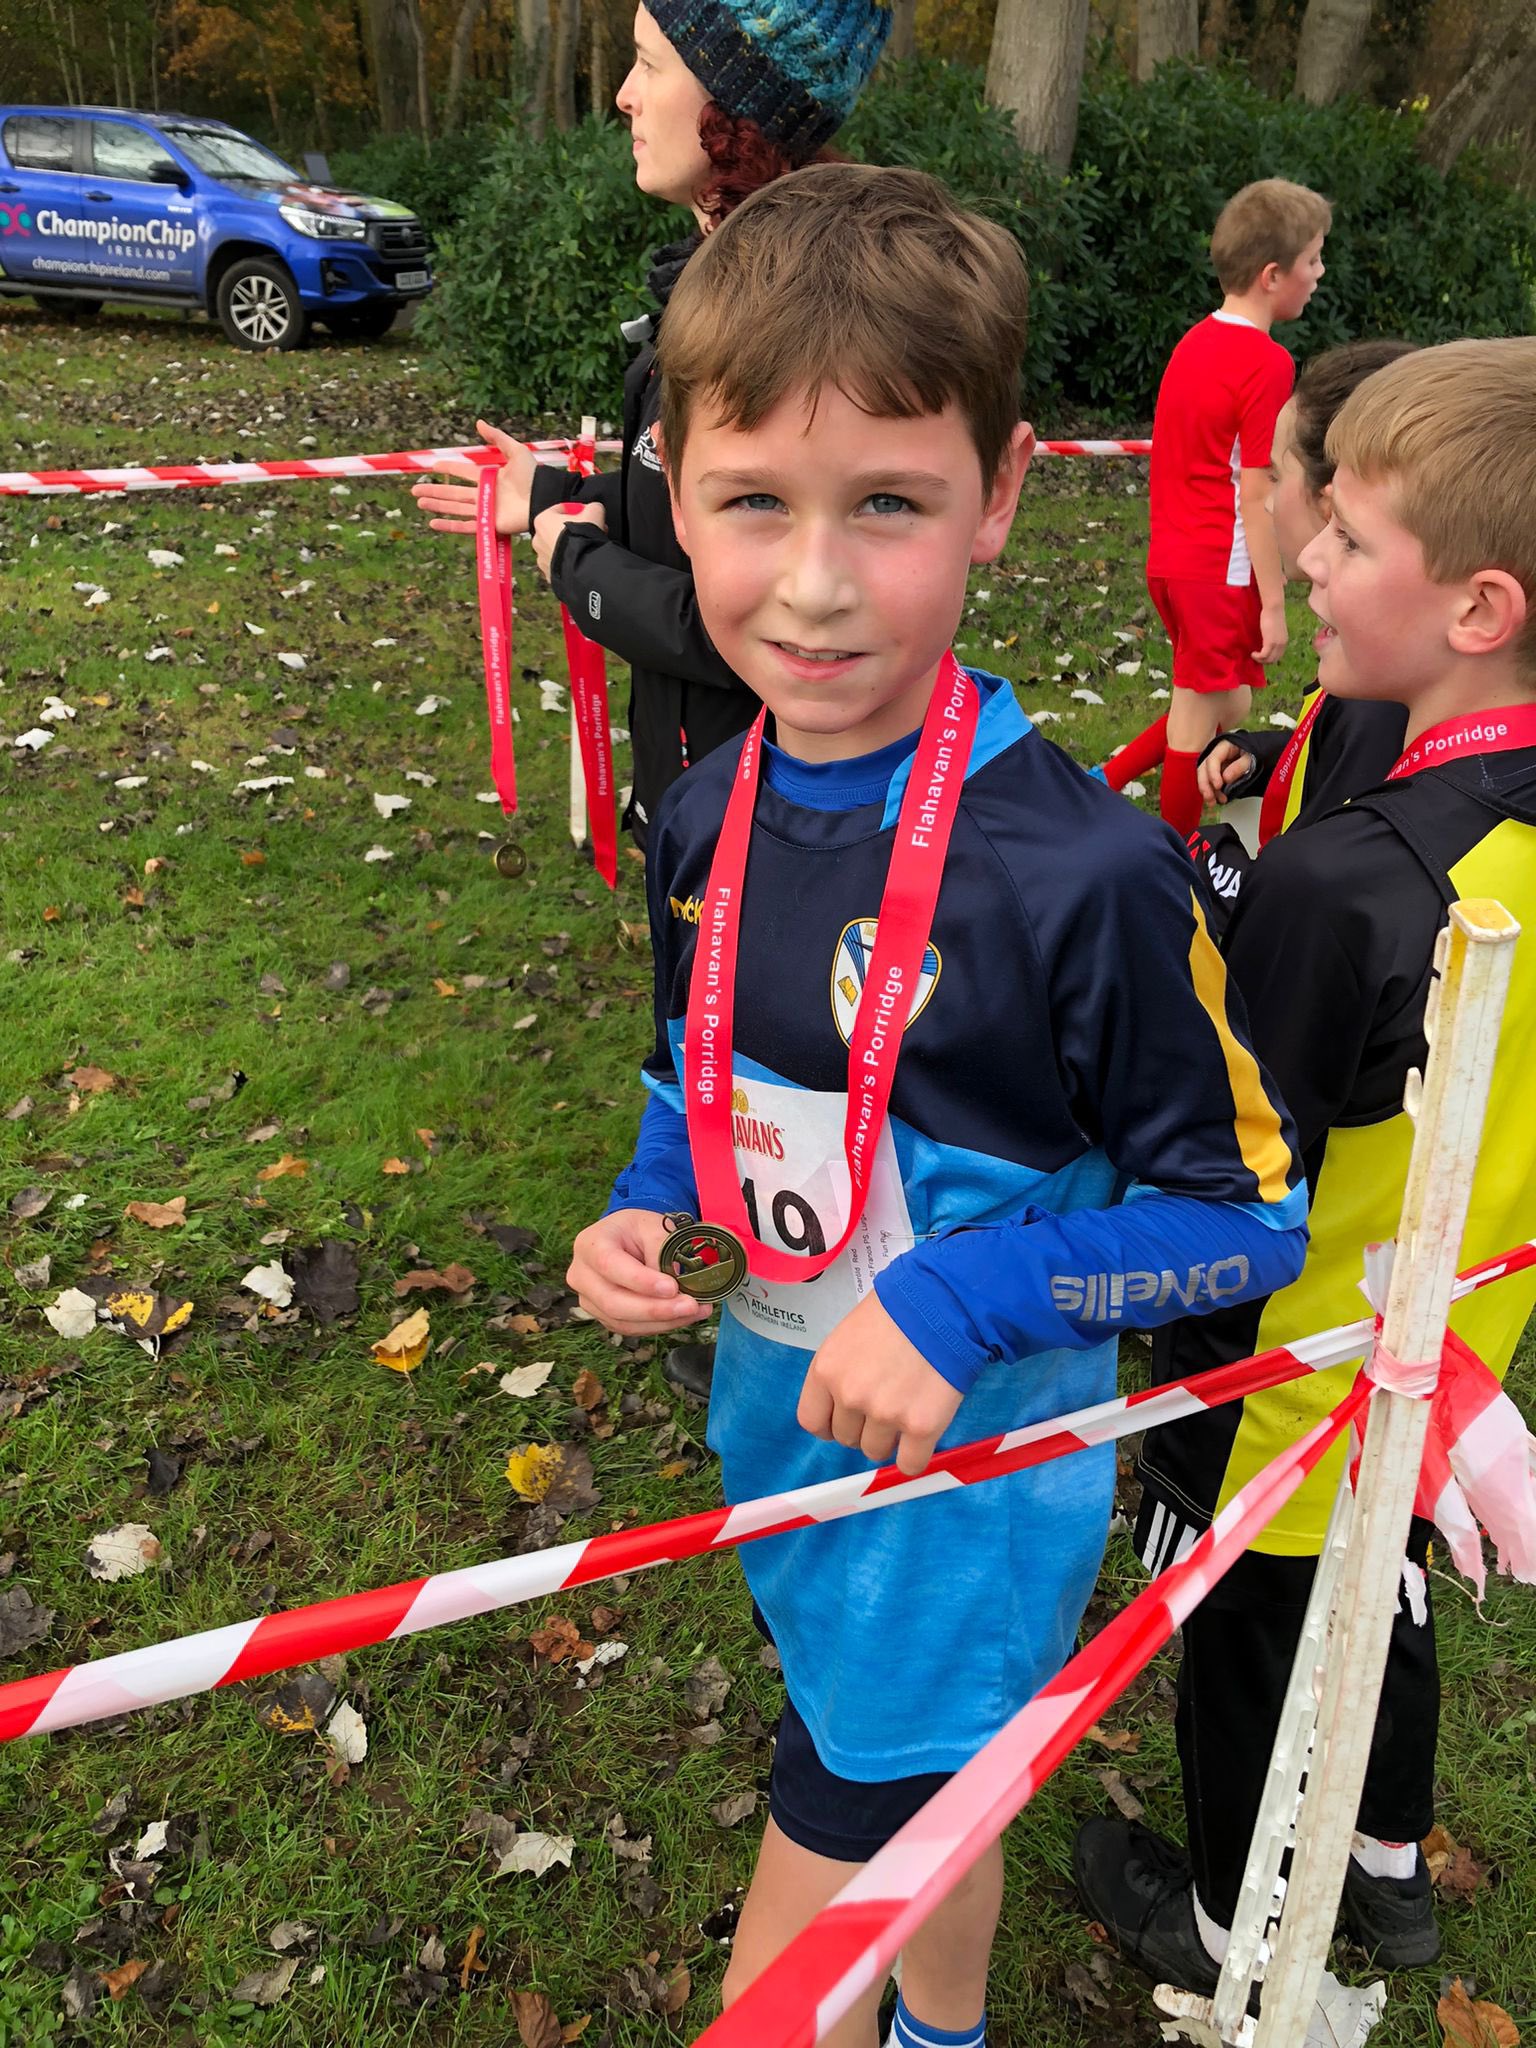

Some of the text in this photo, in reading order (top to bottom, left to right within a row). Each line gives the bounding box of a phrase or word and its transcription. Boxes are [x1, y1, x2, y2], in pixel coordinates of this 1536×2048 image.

[36, 209, 196, 252] ChampionChip
[32, 256, 170, 281] championchipireland.com
[107, 245, 176, 261] IRELAND
[490, 626, 500, 669] Porridge
[592, 694, 608, 796] Flahavan's Porridge
[1424, 723, 1508, 755] Porridge
[1279, 741, 1299, 783] Porridge
[911, 728, 957, 848] Flahavan's
[697, 887, 732, 1105] Flahavan's Porridge
[863, 966, 903, 1067] Porridge
[851, 1075, 877, 1190] Flahavan's
[1050, 1254, 1250, 1321] O'Neills
[751, 1298, 805, 1325] ATHLETICS
[751, 1310, 807, 1333] NORTHERN IRELAND
